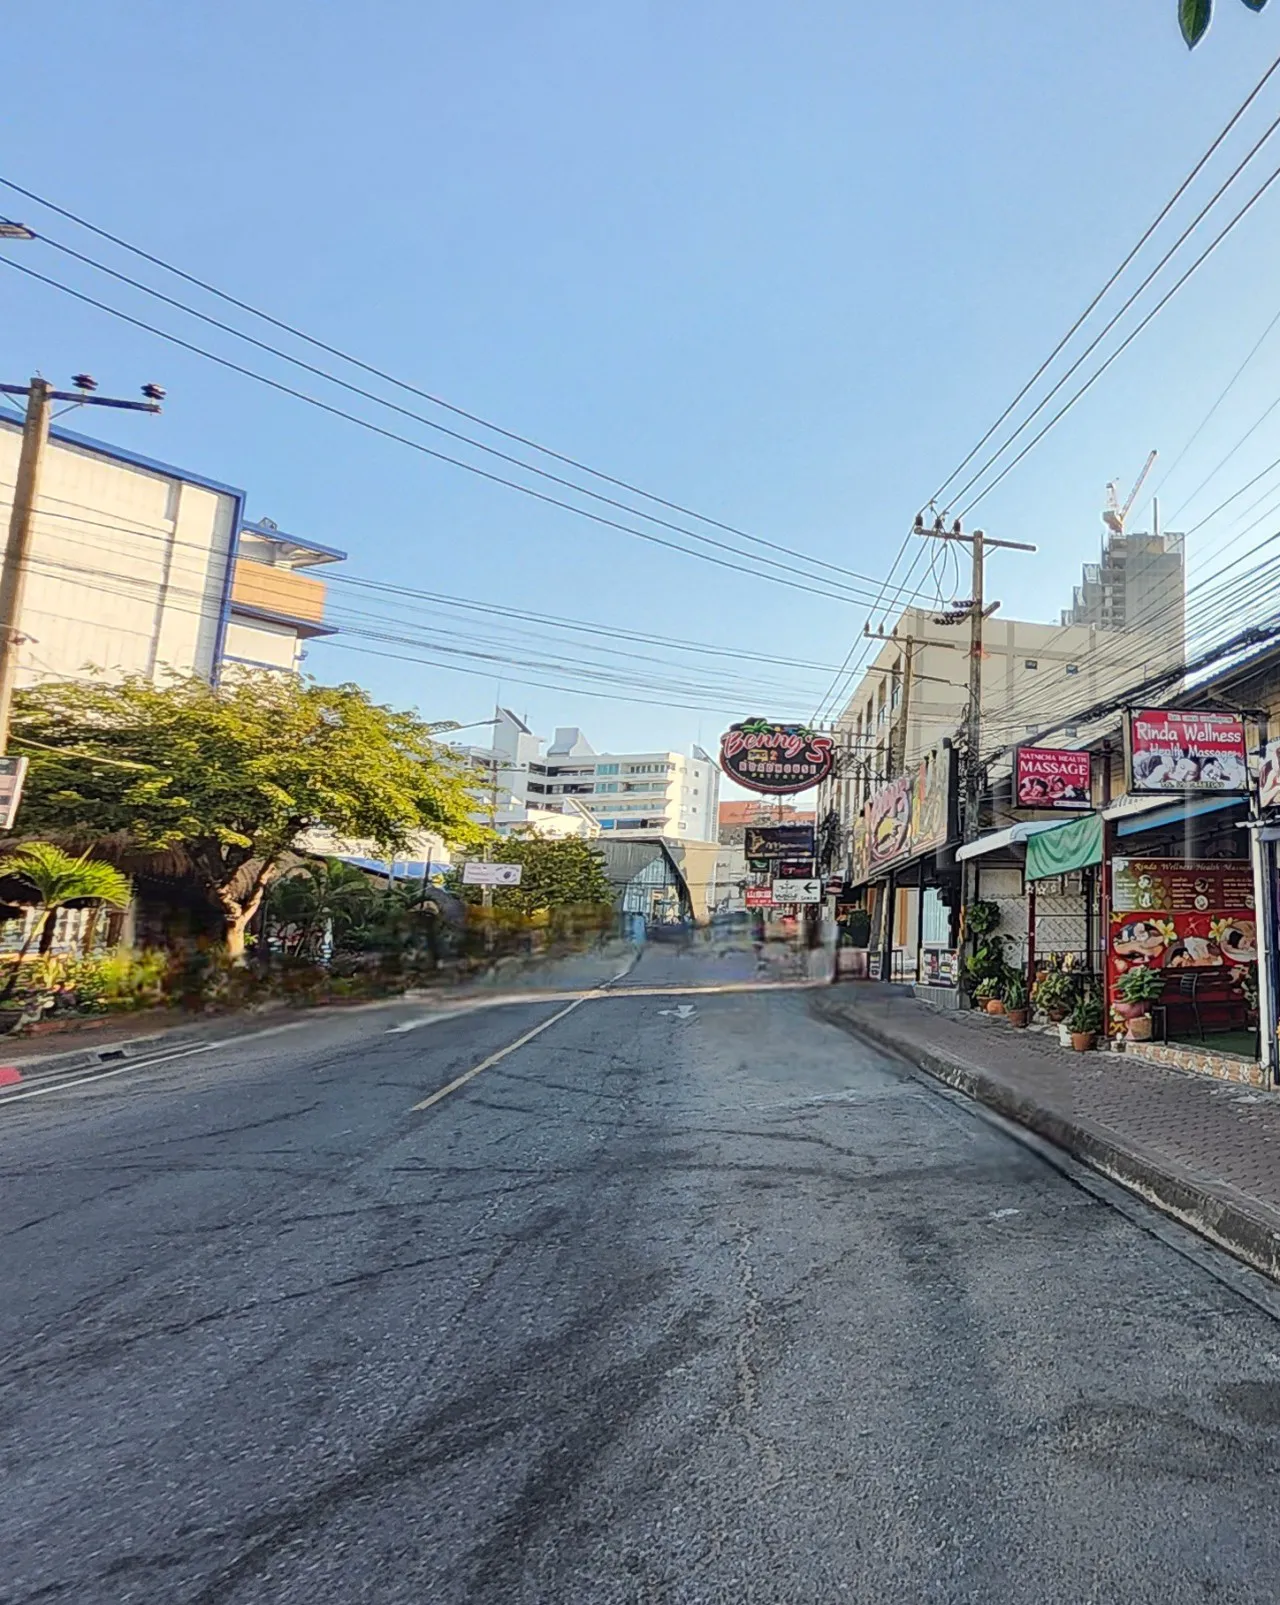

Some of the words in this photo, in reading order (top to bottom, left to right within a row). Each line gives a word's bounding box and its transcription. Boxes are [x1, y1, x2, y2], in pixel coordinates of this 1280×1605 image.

[1135, 721, 1178, 741] Rinda
[1183, 723, 1242, 743] Wellness
[1149, 742, 1185, 760] Health
[1058, 755, 1088, 763] HEALTH
[1020, 761, 1088, 776] MASSAGE
[1161, 863, 1194, 871] Wellness
